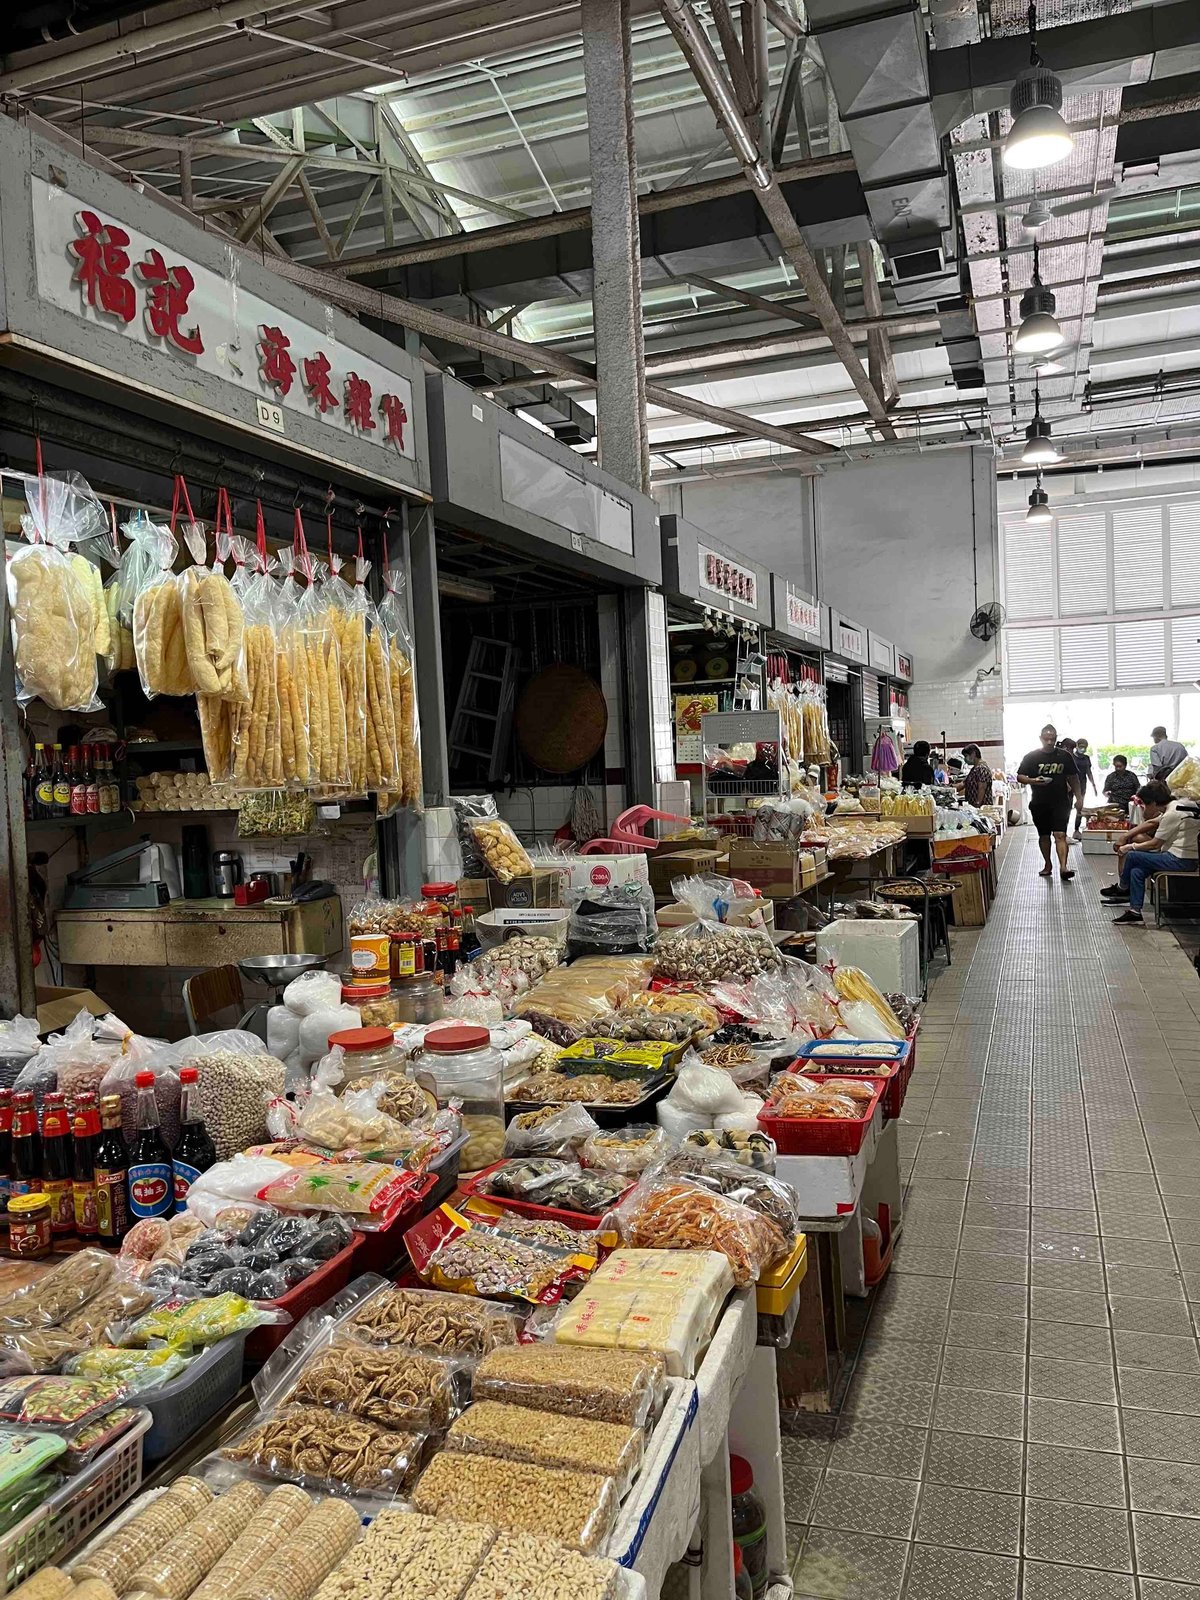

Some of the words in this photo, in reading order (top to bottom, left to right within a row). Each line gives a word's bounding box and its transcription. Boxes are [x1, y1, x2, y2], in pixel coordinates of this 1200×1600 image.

[67, 210, 205, 355] 福記
[256, 323, 408, 452] 海味雜貨
